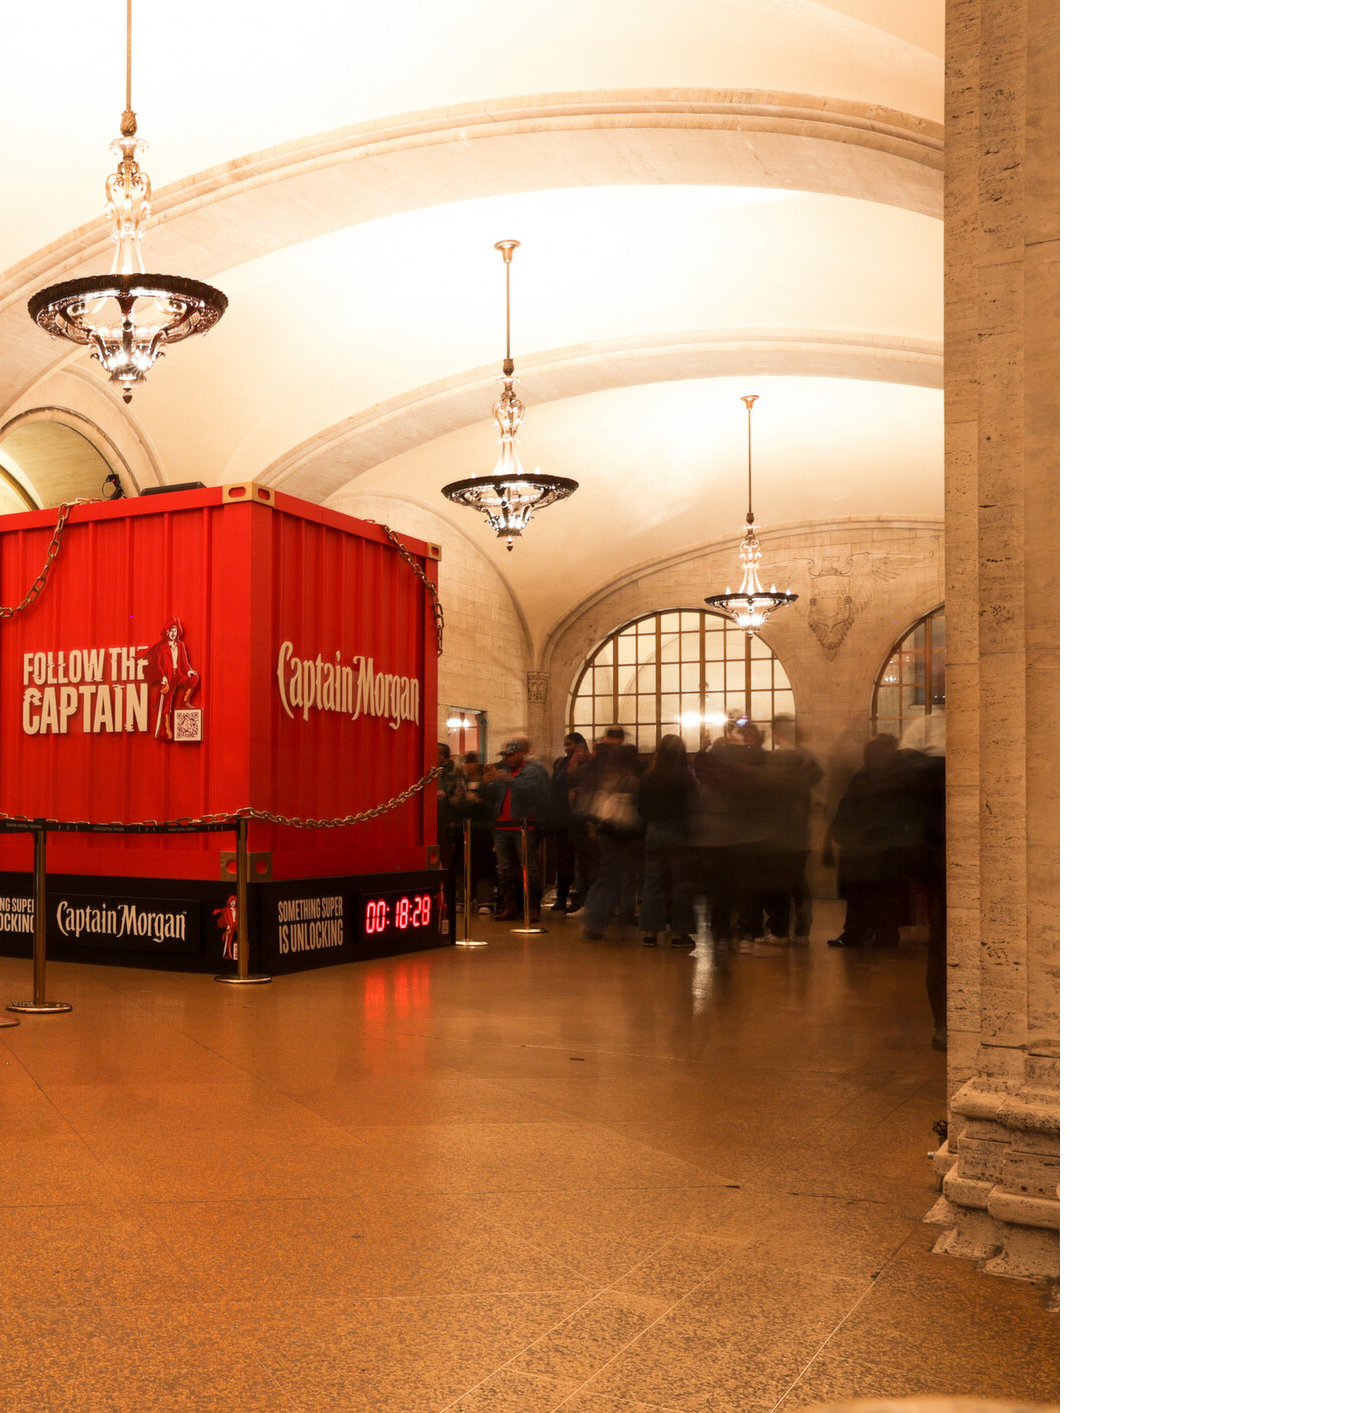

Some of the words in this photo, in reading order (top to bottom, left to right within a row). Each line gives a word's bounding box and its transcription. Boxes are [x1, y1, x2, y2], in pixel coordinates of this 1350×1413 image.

[23, 648, 106, 686] FOLLOW
[108, 645, 149, 681] THE
[277, 641, 353, 721] Captain
[351, 655, 420, 730] Morgan
[22, 682, 149, 735] CAPTAIN
[56, 901, 118, 938] Captain
[278, 897, 321, 923] SOMETHING
[321, 896, 343, 919] SUPER
[278, 924, 290, 954] IS
[290, 918, 344, 952] UNLOCKING
